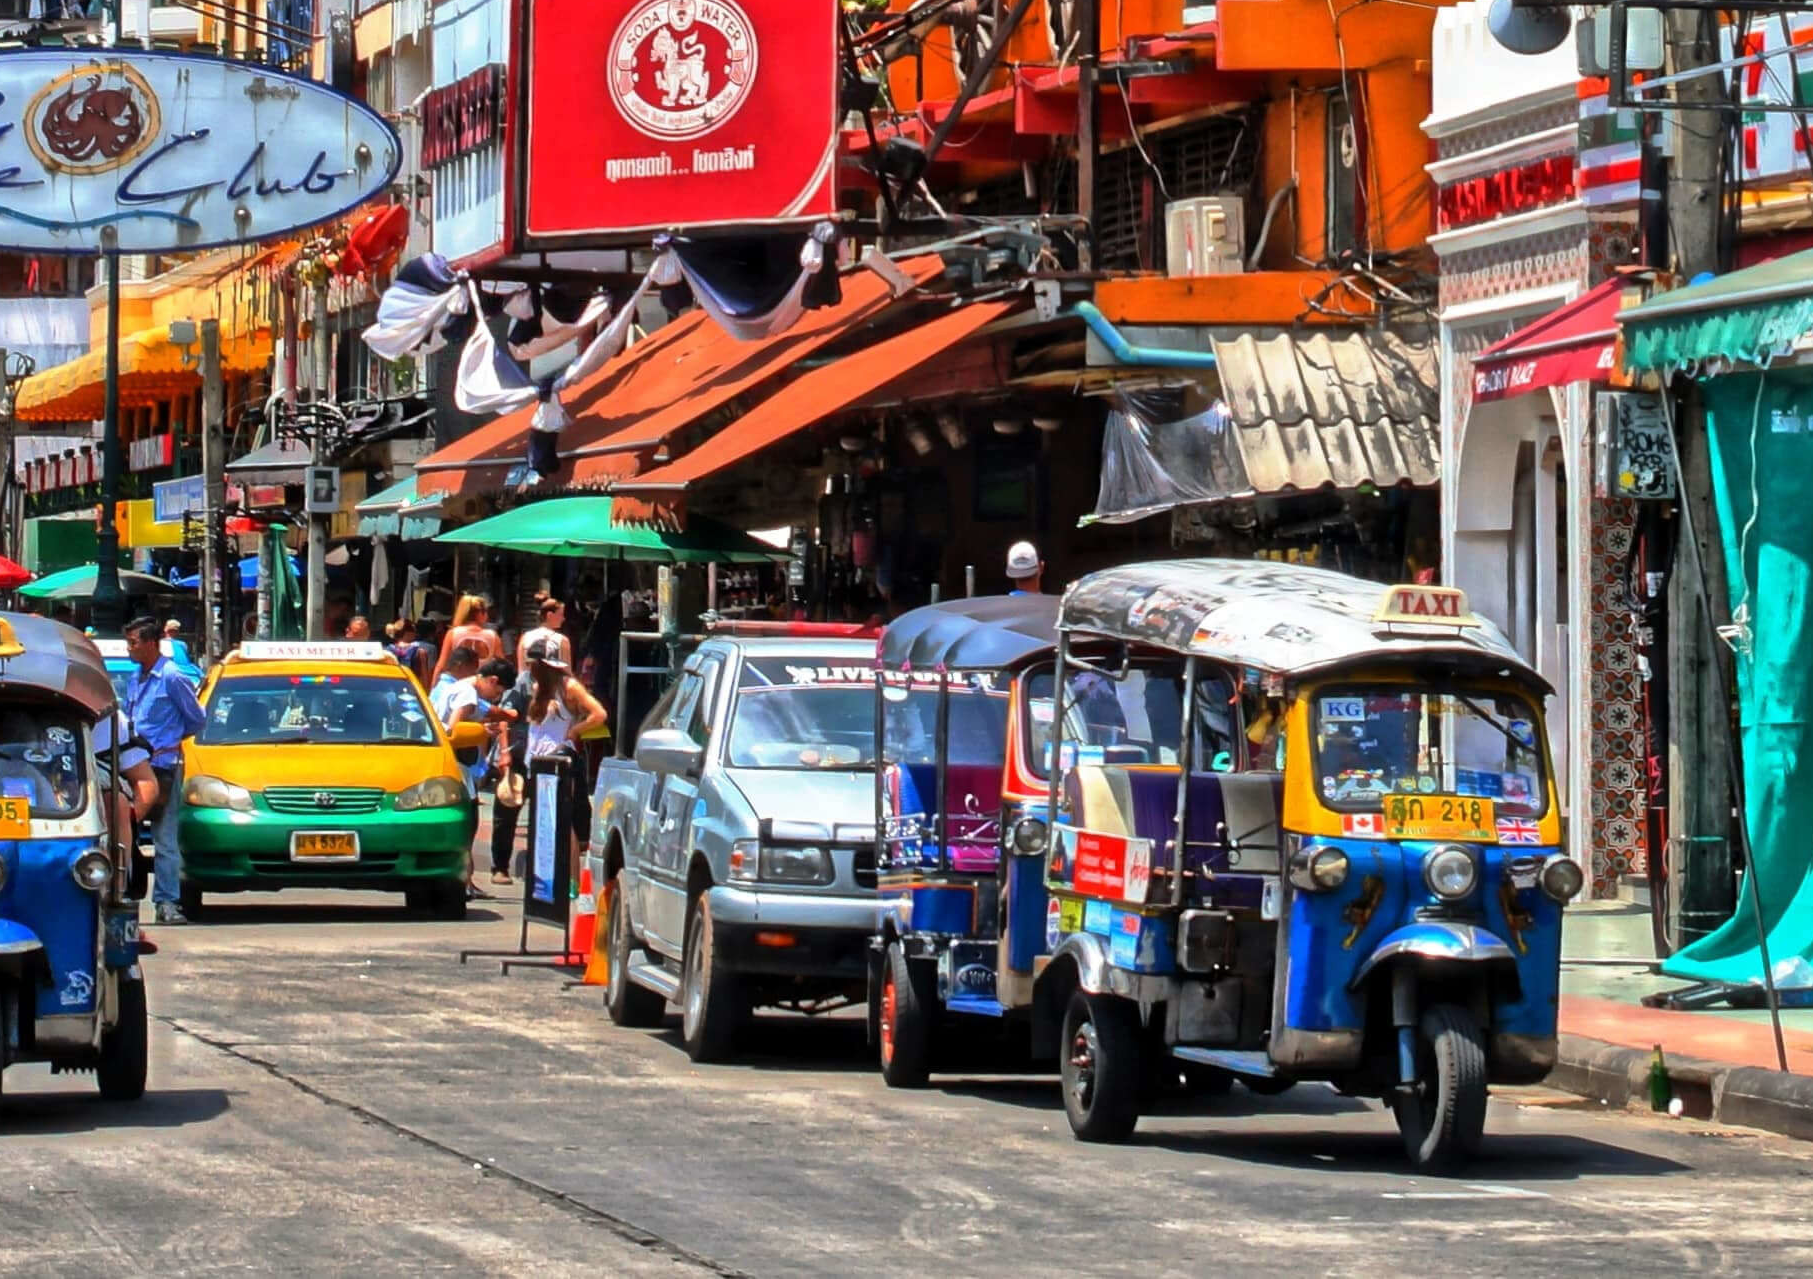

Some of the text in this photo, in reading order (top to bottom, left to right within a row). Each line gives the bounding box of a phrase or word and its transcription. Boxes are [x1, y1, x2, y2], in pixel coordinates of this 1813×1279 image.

[627, 3, 742, 48] SODA WATER
[116, 127, 357, 204] Club
[1397, 590, 1462, 618] TAXI
[266, 645, 357, 658] TAXI METER
[816, 665, 970, 687] LIVEPOOL
[1326, 701, 1361, 718] KG
[1441, 800, 1482, 825] 218
